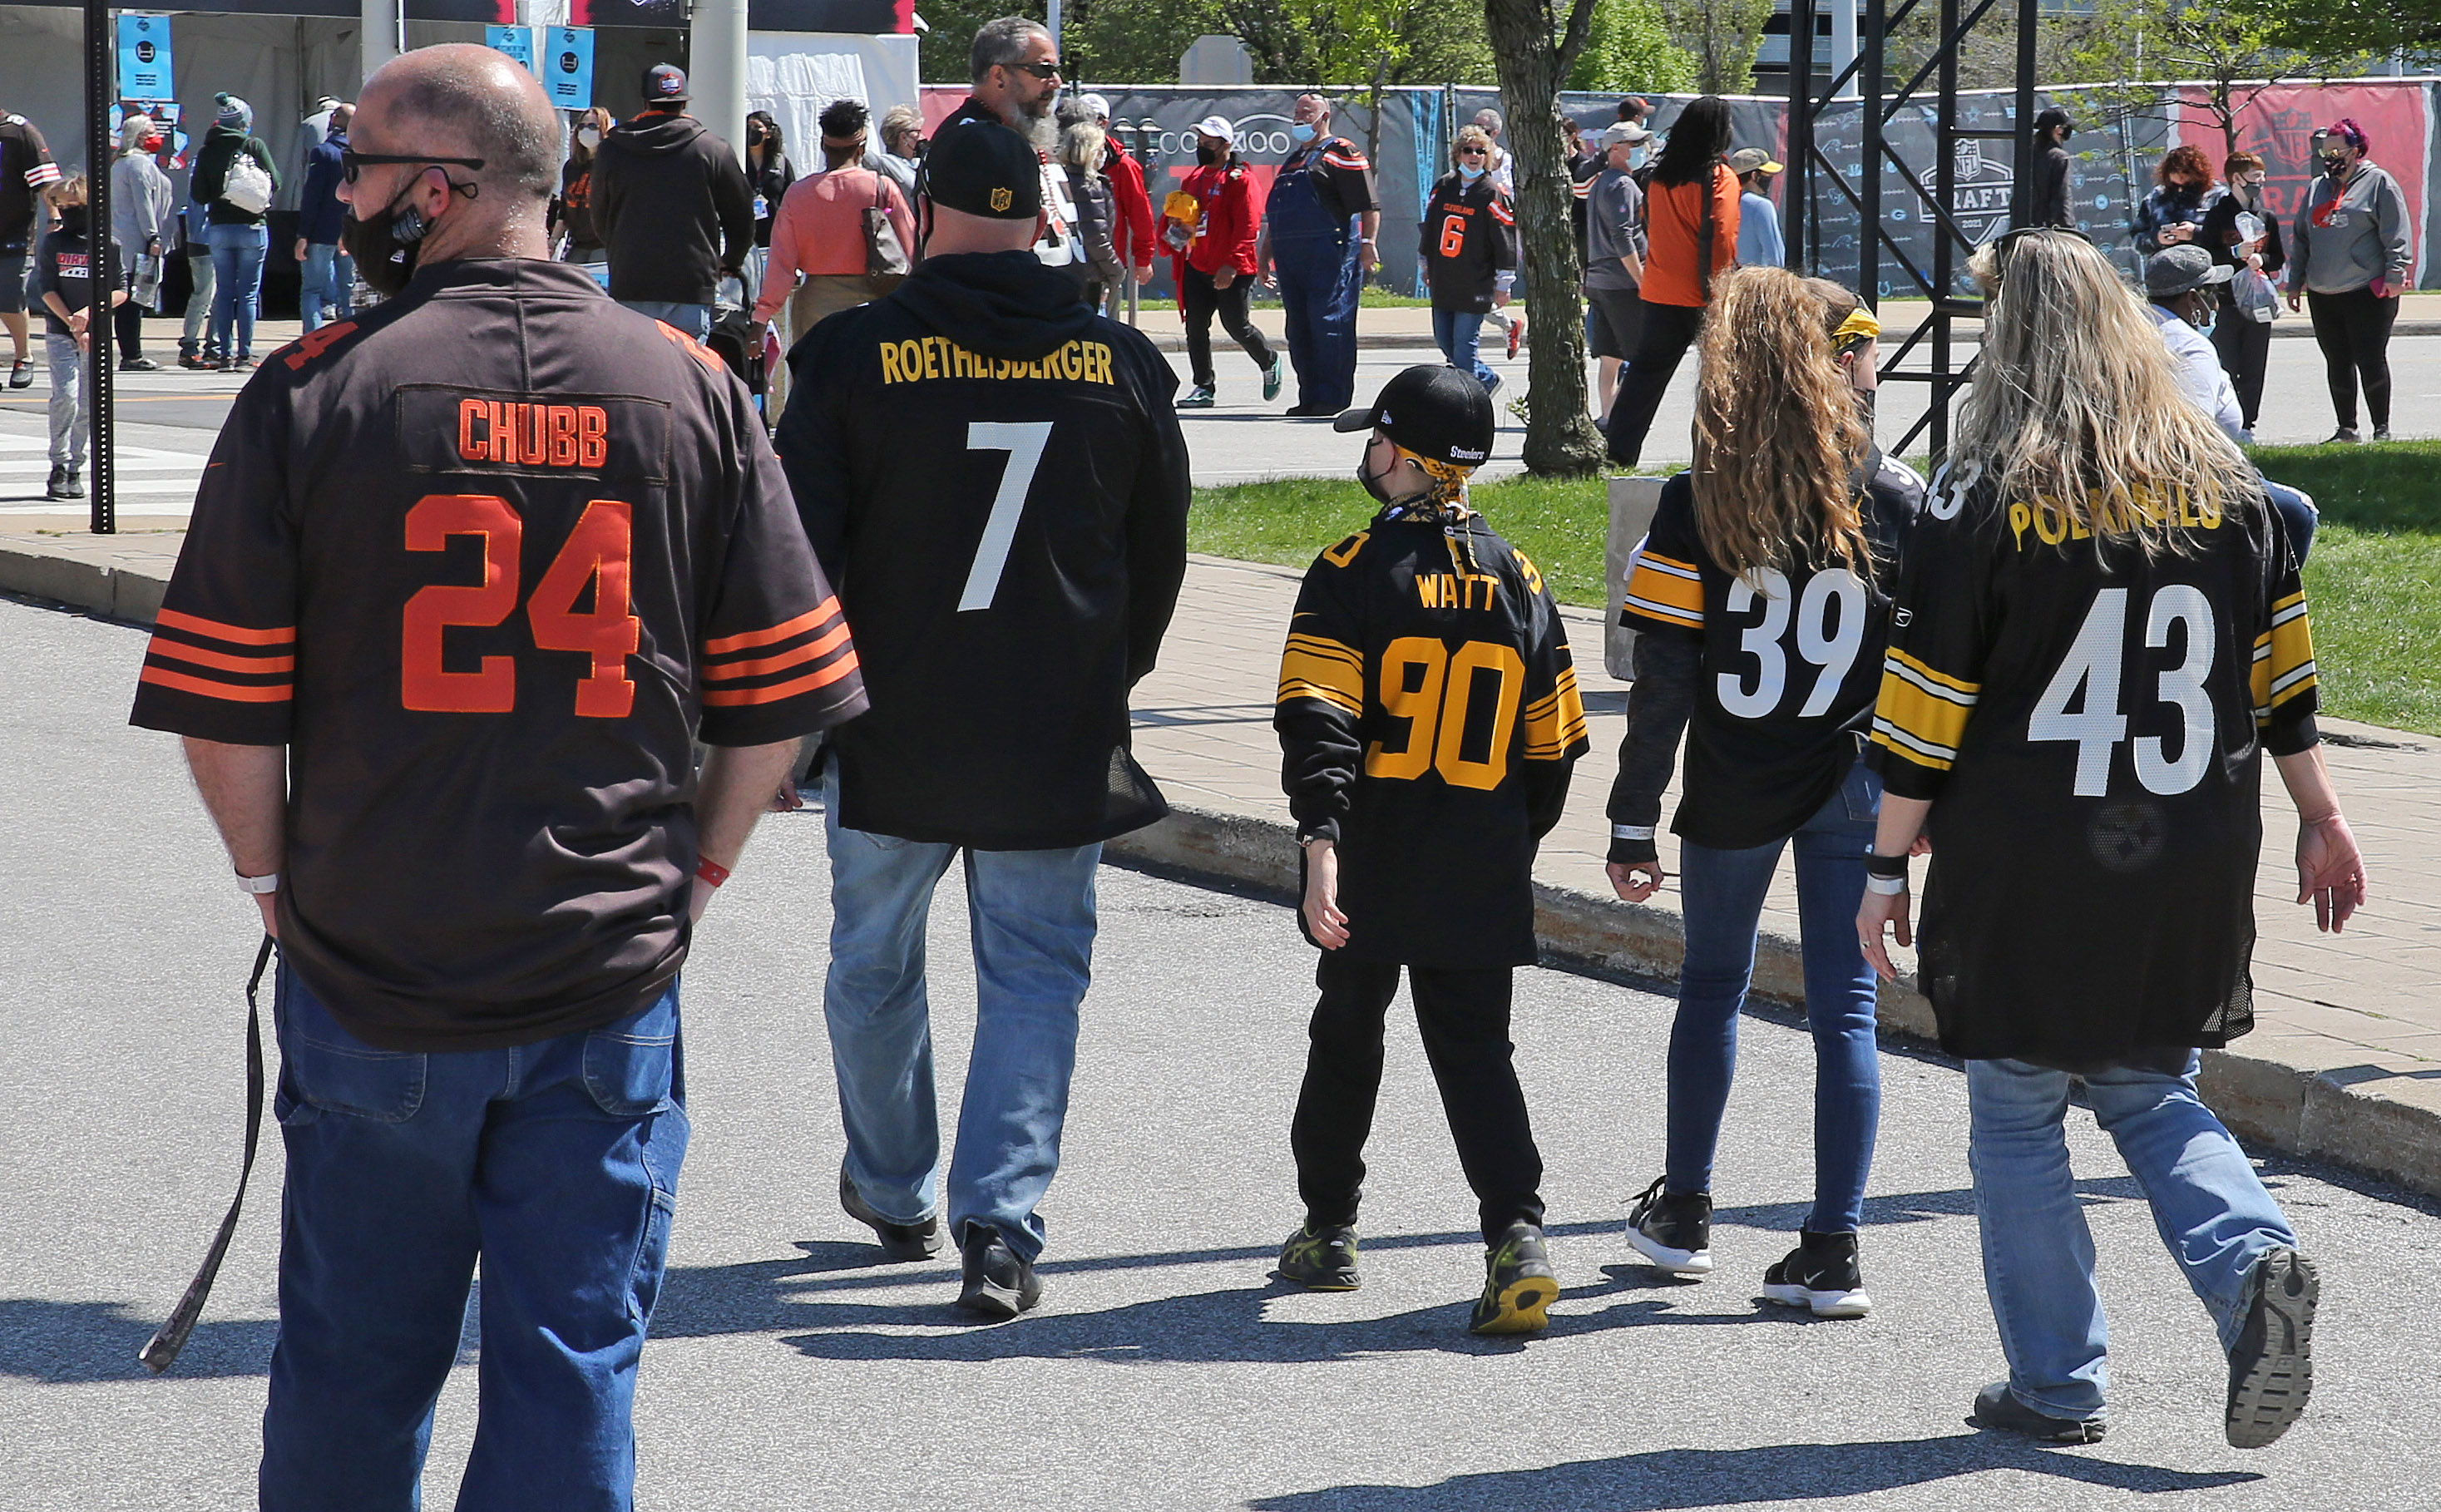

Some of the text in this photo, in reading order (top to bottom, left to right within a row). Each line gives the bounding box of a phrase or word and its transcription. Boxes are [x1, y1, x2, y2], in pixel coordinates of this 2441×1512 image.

[1440, 215, 1466, 257] 6
[1953, 188, 2012, 210] AFT
[458, 398, 608, 467] CHUBB
[1450, 446, 1485, 459] Steelers
[957, 422, 1055, 612] 7
[402, 494, 640, 718] 24
[1415, 573, 1500, 611] WATT
[1717, 566, 1867, 719] 39
[1365, 637, 1525, 791] 90
[2027, 584, 2216, 797] 43
